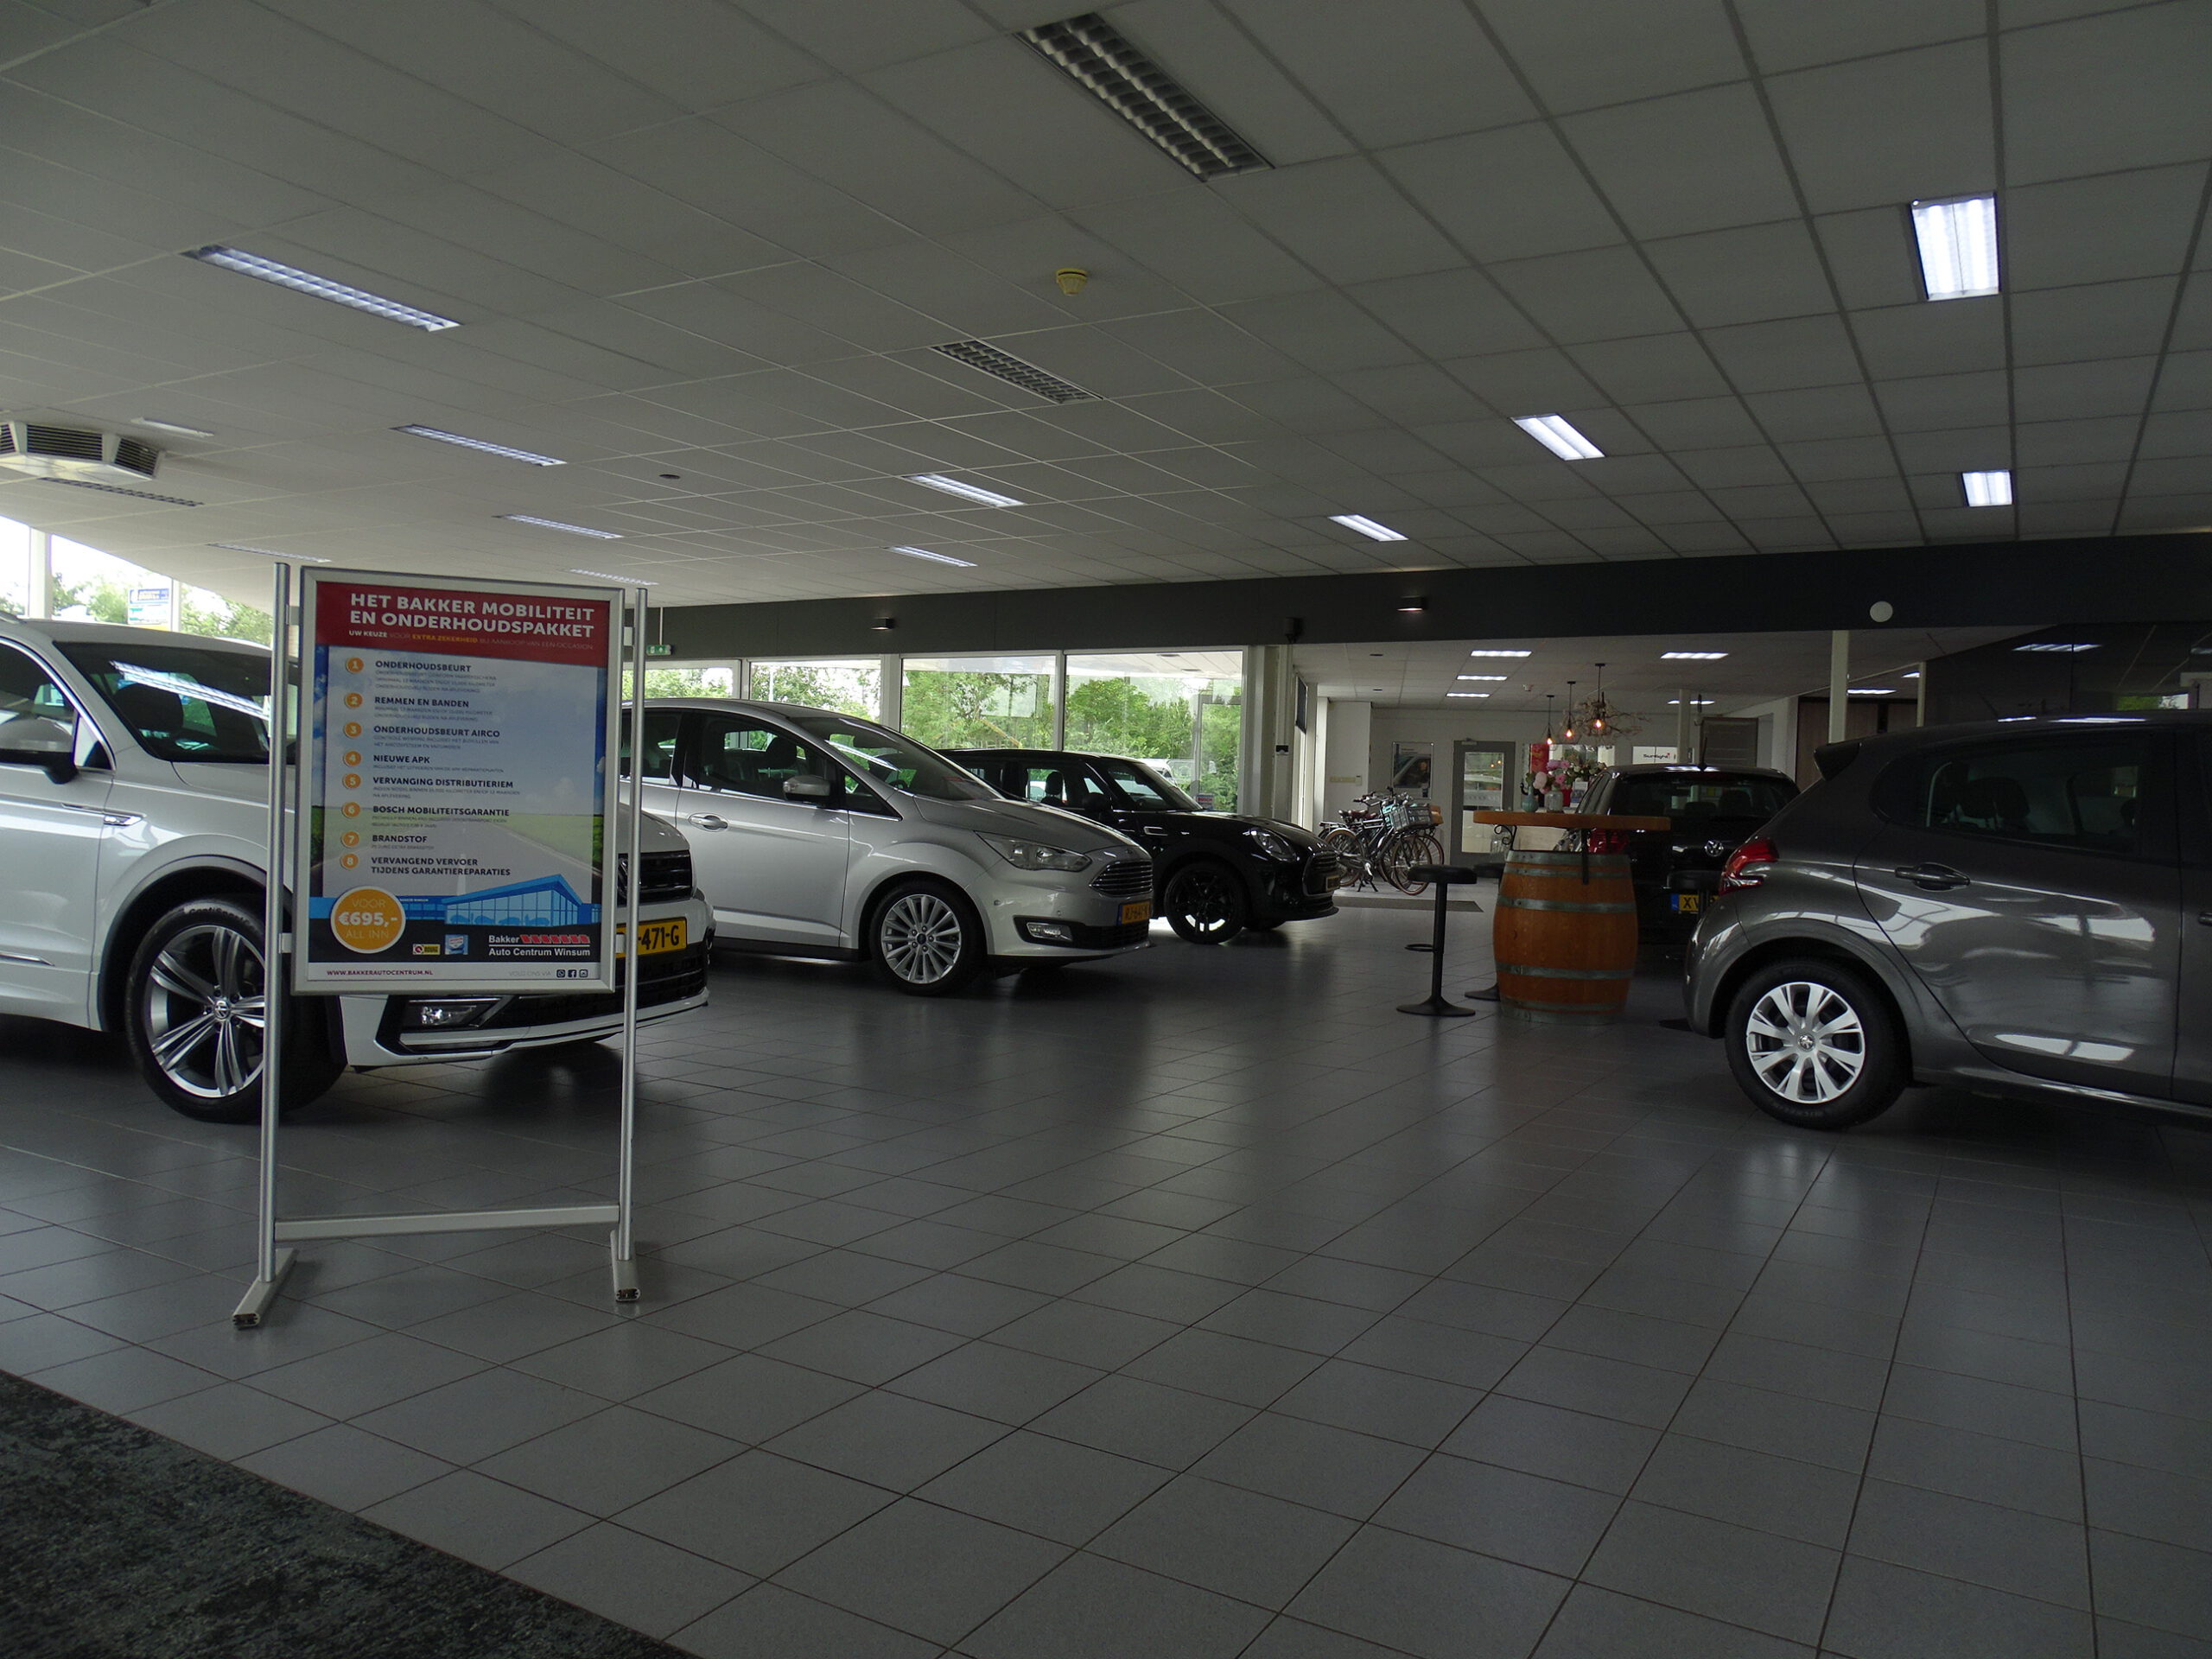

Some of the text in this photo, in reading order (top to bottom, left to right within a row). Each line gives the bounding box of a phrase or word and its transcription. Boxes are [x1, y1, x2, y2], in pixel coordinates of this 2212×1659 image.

[351, 593, 594, 621] HET BAKKER MOBILITEIT
[350, 610, 594, 638] EN ONDERHOUDSPAKKET
[375, 660, 472, 672] ONDERHOUDSBEURT
[374, 696, 415, 706] REMMEN
[432, 699, 469, 708] BANDEN
[373, 725, 469, 736] ONDERHOUDSBEURT
[471, 729, 500, 738] AIRCO
[373, 754, 410, 763] NIEUWE
[373, 777, 434, 786] VERVANGING
[435, 779, 514, 788] DISTRIBUTIERIEM
[407, 807, 510, 817] MOBILITEITSGARANTIE
[372, 835, 428, 843] BRANDSTOF
[412, 867, 511, 876] GARANTIEREPARATIES
[352, 898, 386, 908] VOOR
[338, 912, 398, 927] €695,-
[346, 929, 389, 940] ALL INN
[488, 934, 520, 944] Bakker
[638, 925, 679, 950] -471-G
[488, 948, 591, 957] Auto Centrum Winsum
